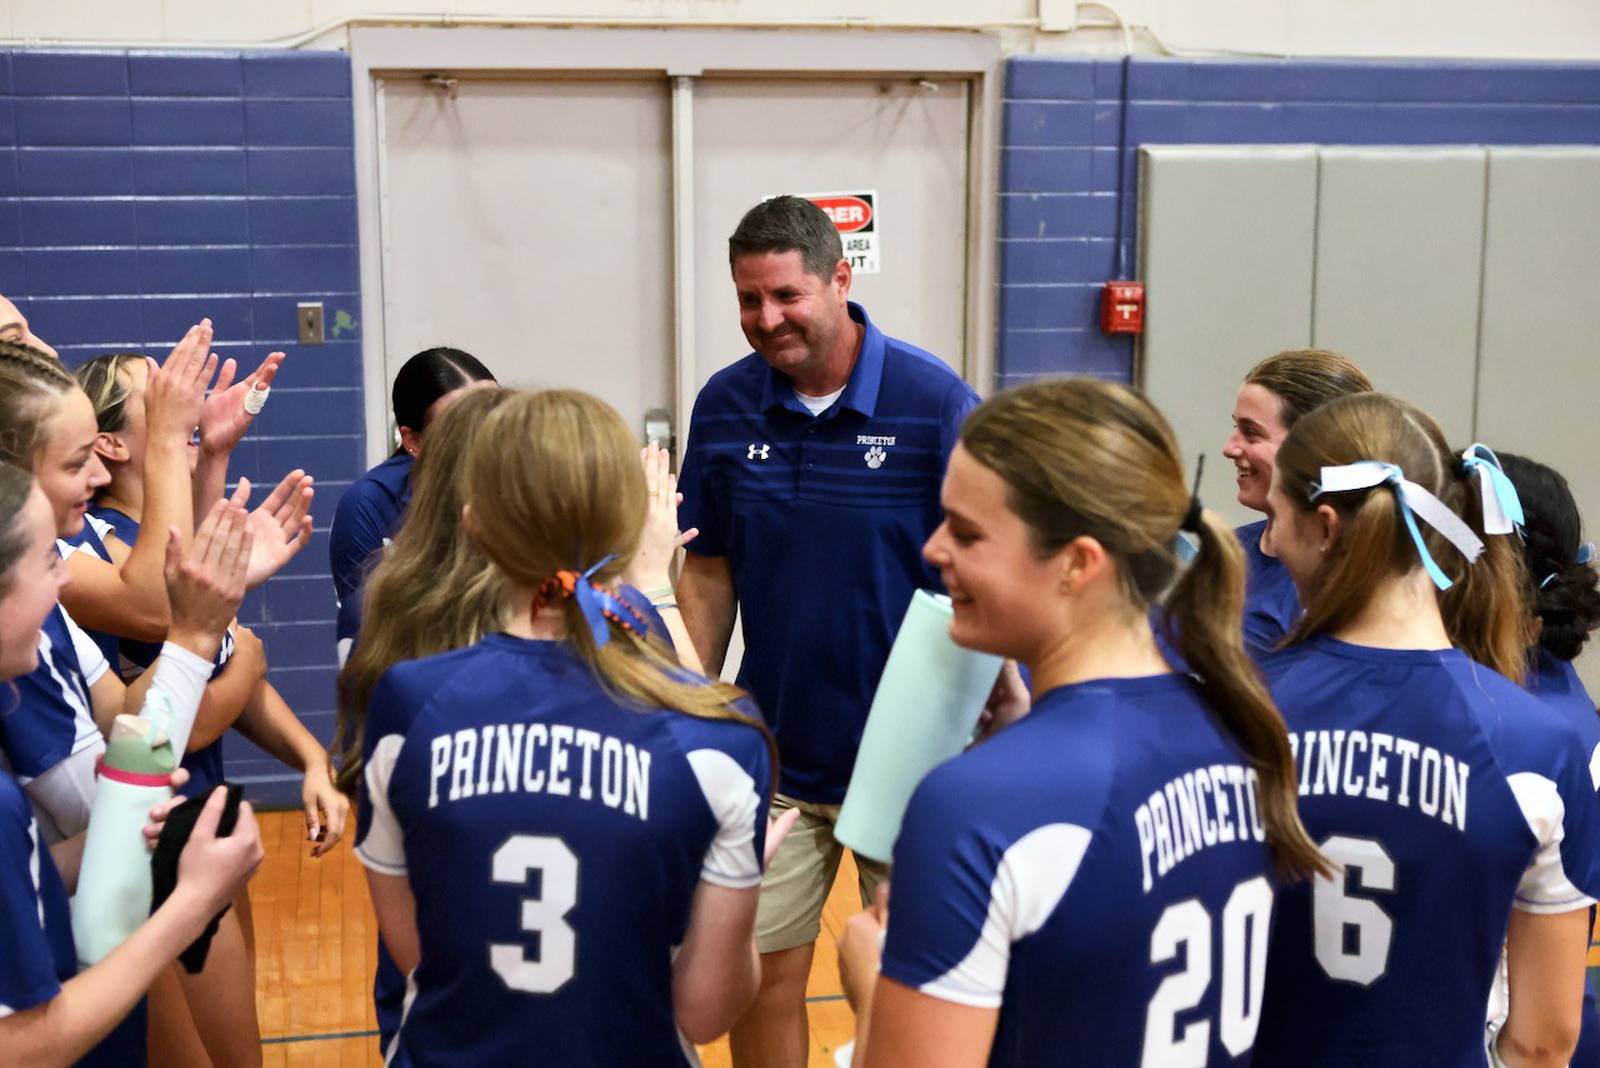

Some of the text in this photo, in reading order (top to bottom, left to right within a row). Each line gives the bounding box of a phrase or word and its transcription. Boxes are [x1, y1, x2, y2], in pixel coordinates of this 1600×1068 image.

[856, 435, 896, 446] PRINCETON
[428, 723, 651, 821] PRINCETON
[1134, 764, 1266, 894] PRINCETO
[1287, 730, 1470, 832] INCETON
[490, 835, 579, 994] 3
[1141, 875, 1274, 1068] 20
[1313, 835, 1396, 987] 6
